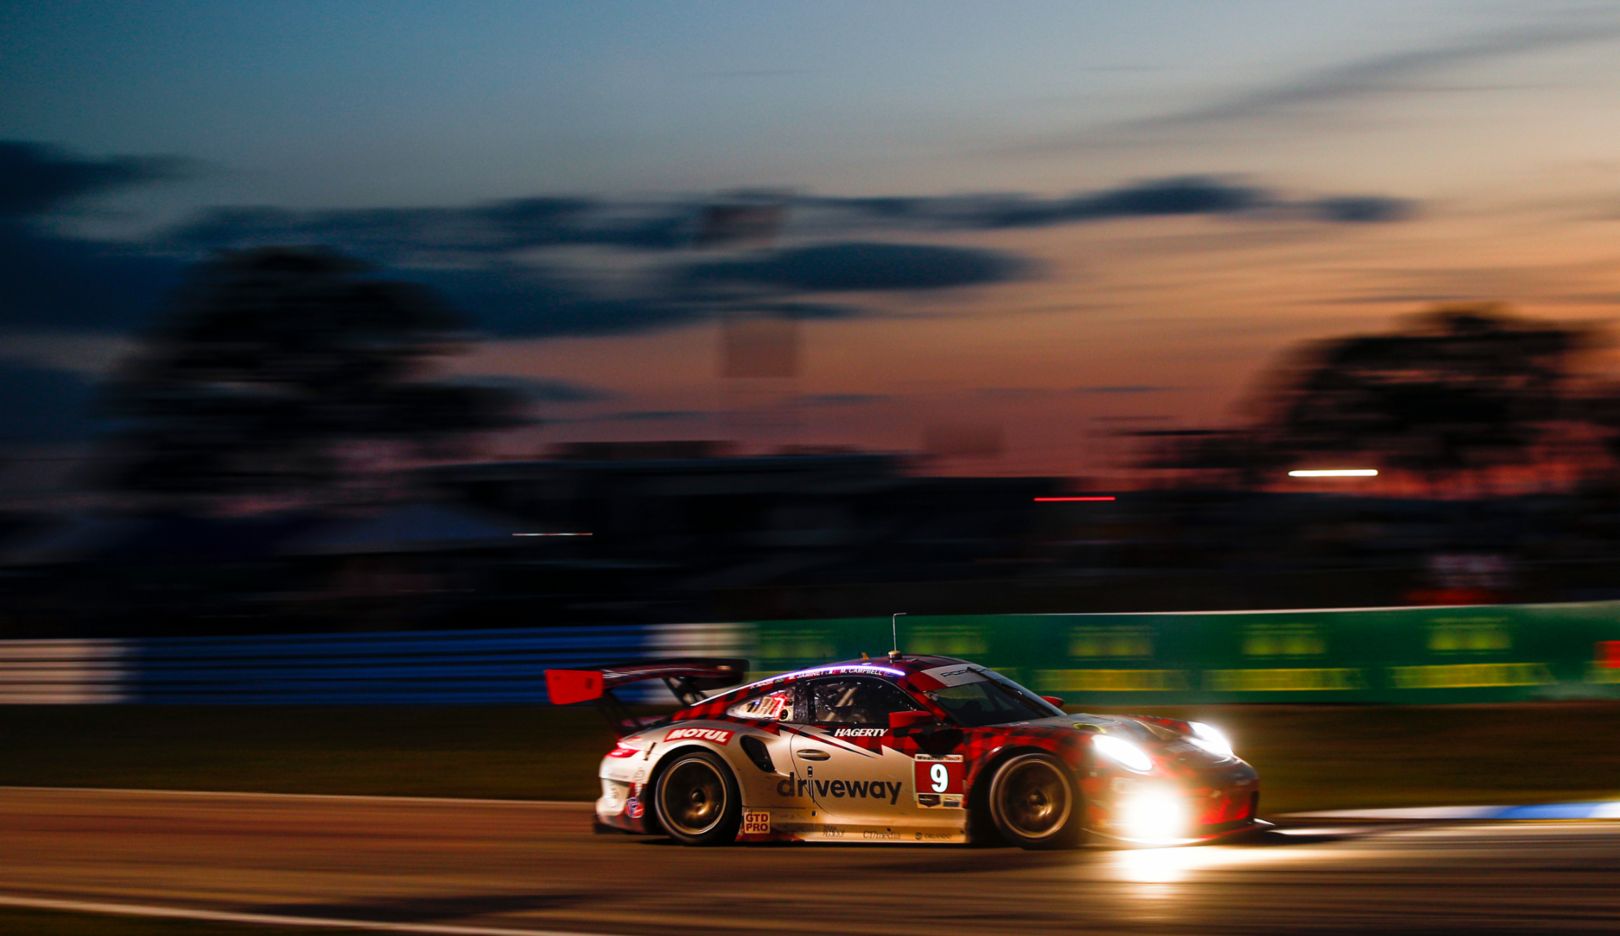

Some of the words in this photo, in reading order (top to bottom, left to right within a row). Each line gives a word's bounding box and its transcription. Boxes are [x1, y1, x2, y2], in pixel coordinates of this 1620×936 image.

[667, 728, 729, 742] MOTUL
[834, 728, 888, 737] HAGERTY
[930, 763, 949, 793] 9
[776, 766, 902, 805] driveway
[745, 813, 769, 822] GTD
[746, 823, 769, 832] PRO
